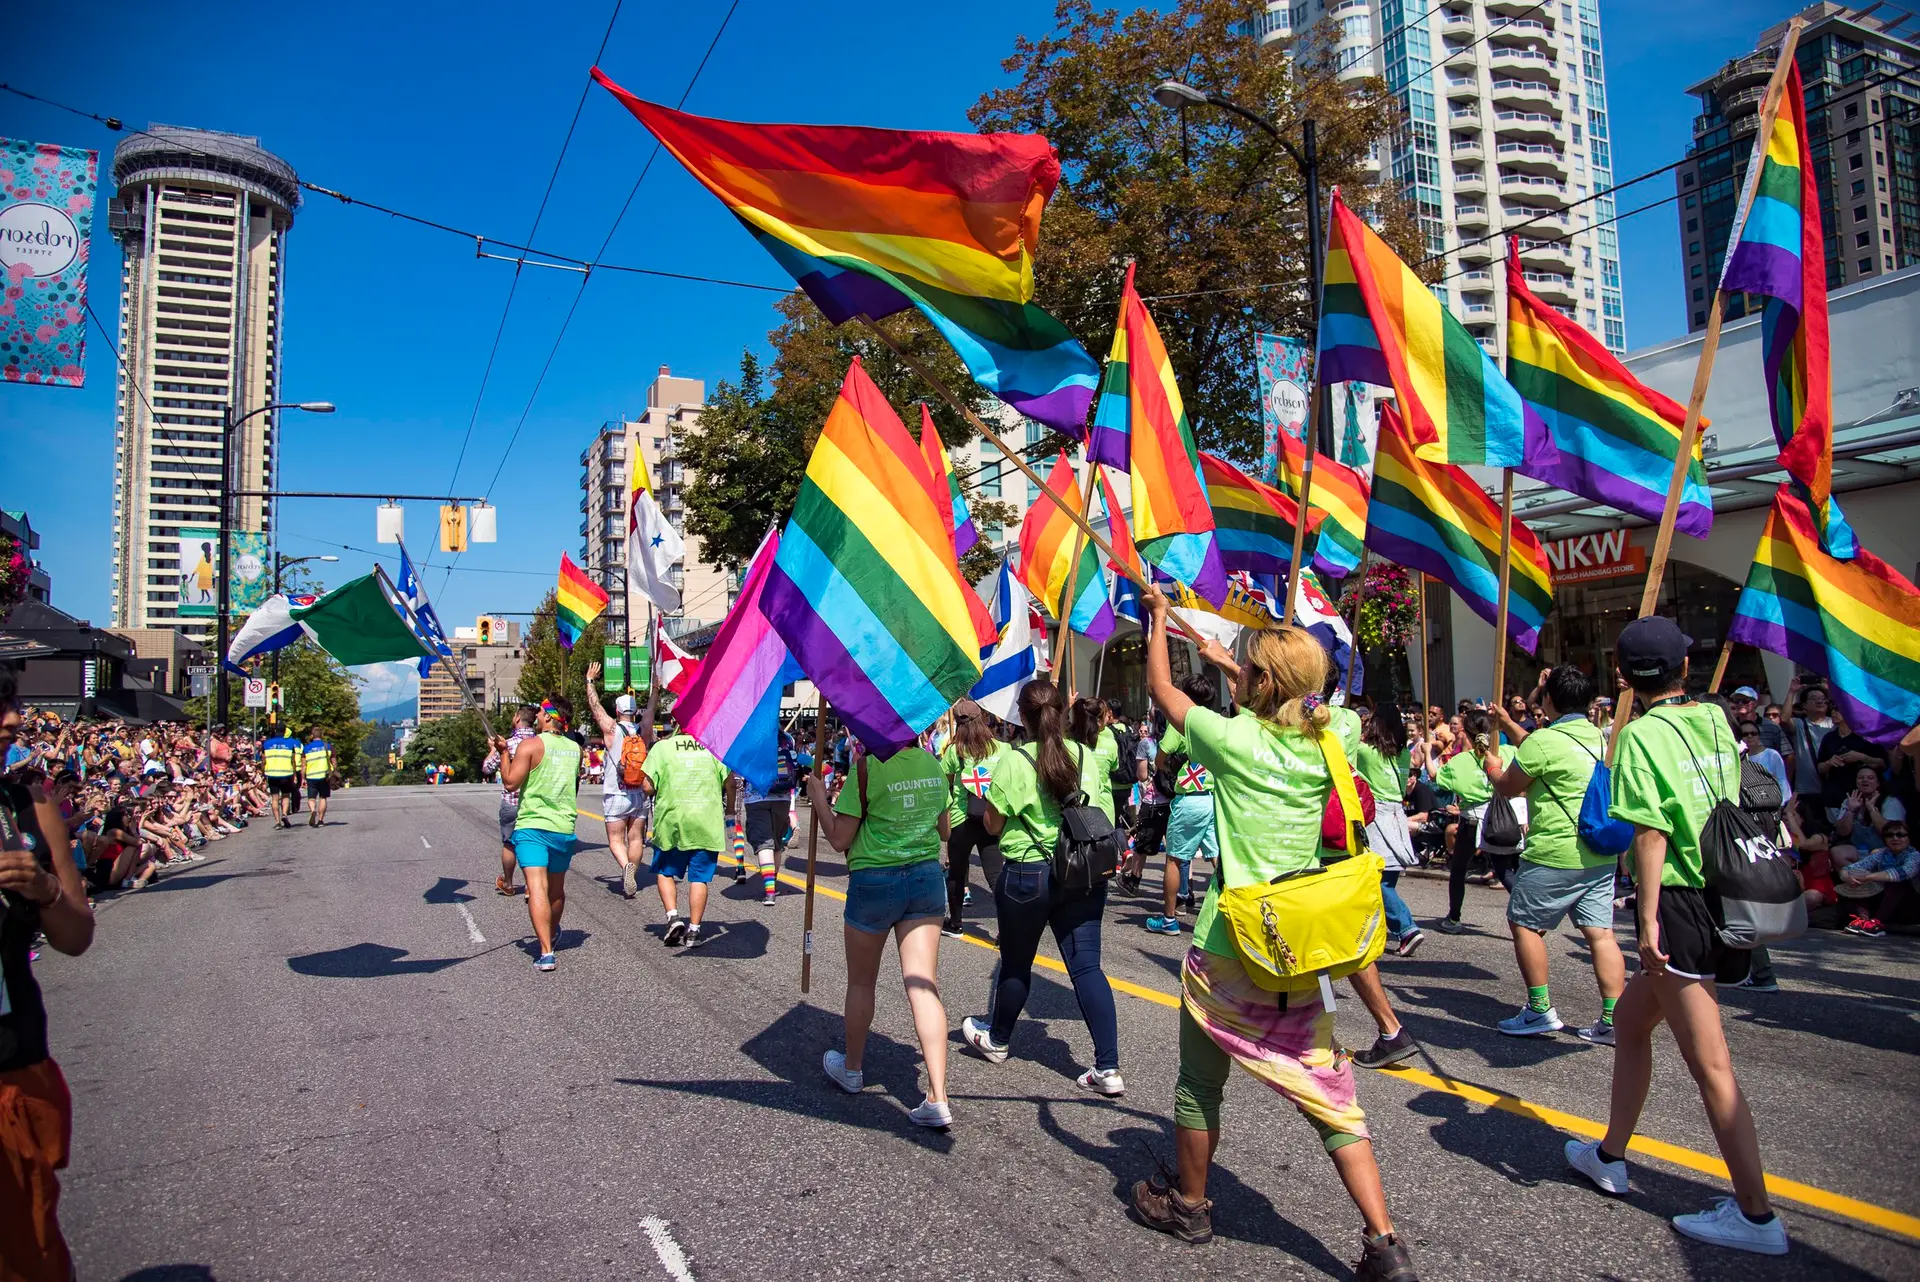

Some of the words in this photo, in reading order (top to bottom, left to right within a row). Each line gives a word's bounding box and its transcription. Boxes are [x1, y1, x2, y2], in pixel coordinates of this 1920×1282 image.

[1556, 572, 1579, 582] WORLD
[1580, 567, 1612, 578] HANDBAG
[1613, 564, 1635, 574] STORE
[786, 709, 819, 717] COFEE
[887, 777, 942, 793] VOLUNTEER
